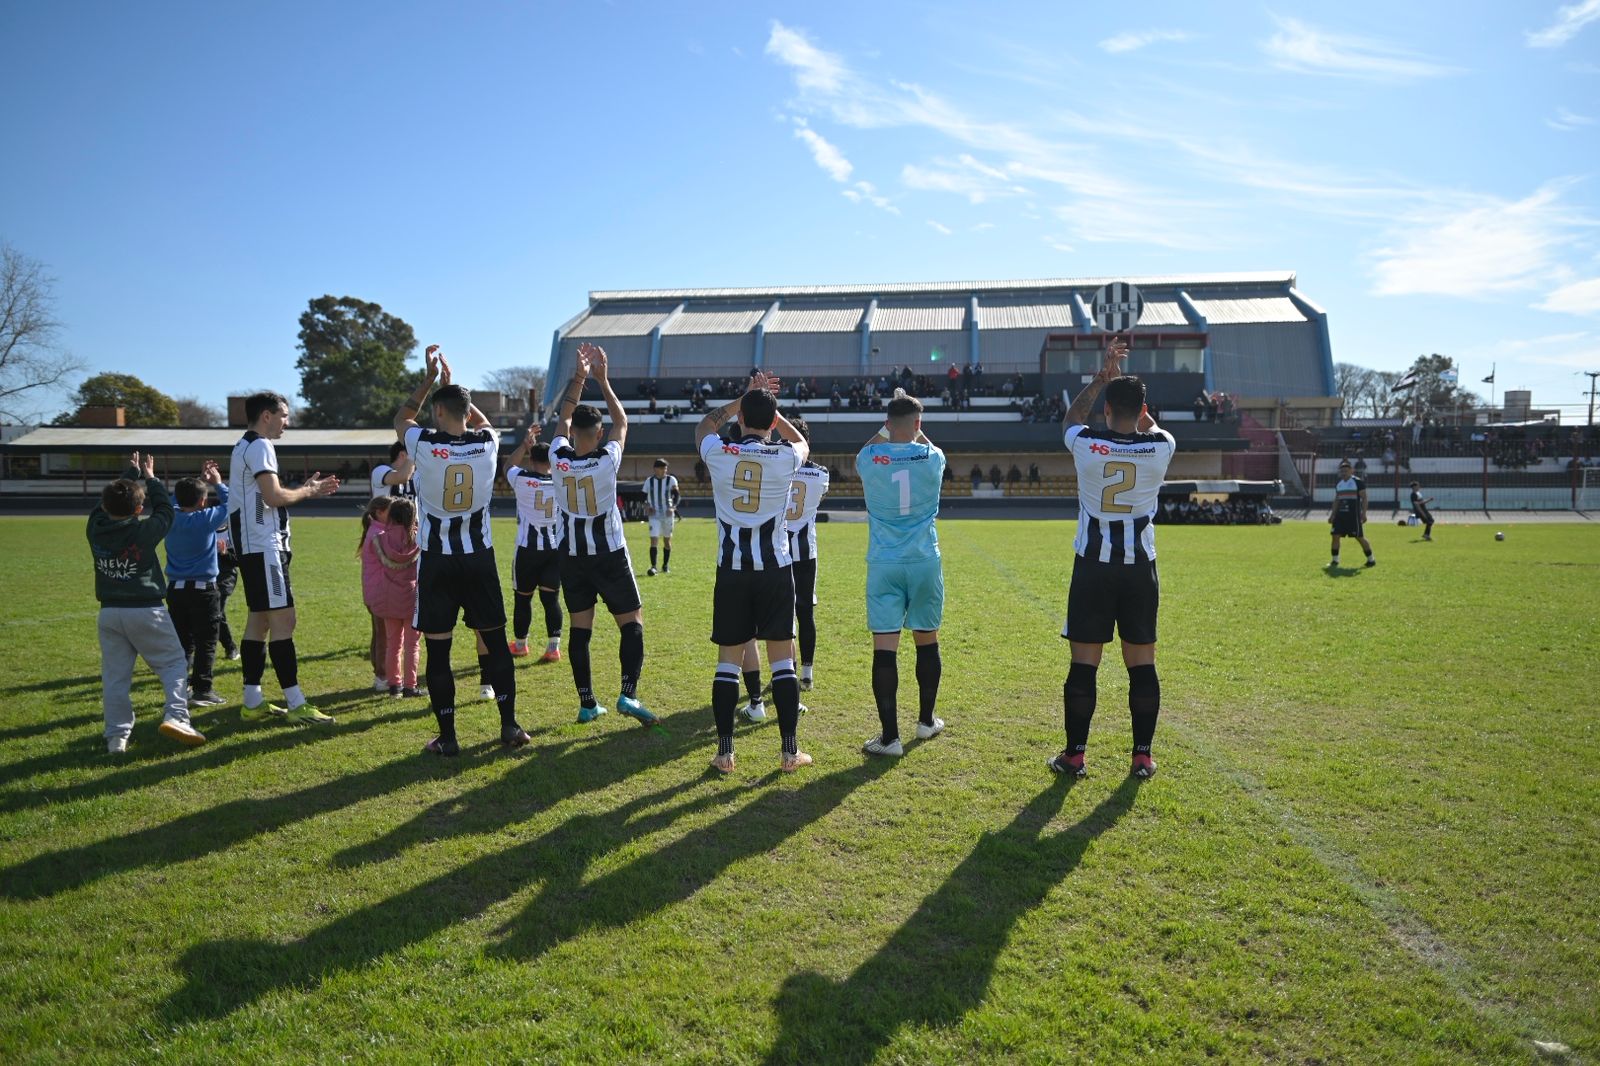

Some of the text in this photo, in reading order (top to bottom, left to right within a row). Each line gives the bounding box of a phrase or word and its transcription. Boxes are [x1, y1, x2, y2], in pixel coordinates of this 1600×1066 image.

[1099, 303, 1136, 313] BELL
[442, 463, 474, 512] 8
[534, 489, 554, 518] 4
[562, 474, 599, 517] 11
[732, 460, 763, 513] 9
[785, 480, 807, 521] 3
[891, 469, 911, 516] 1
[1100, 460, 1137, 514] 2
[99, 557, 129, 569] NEW
